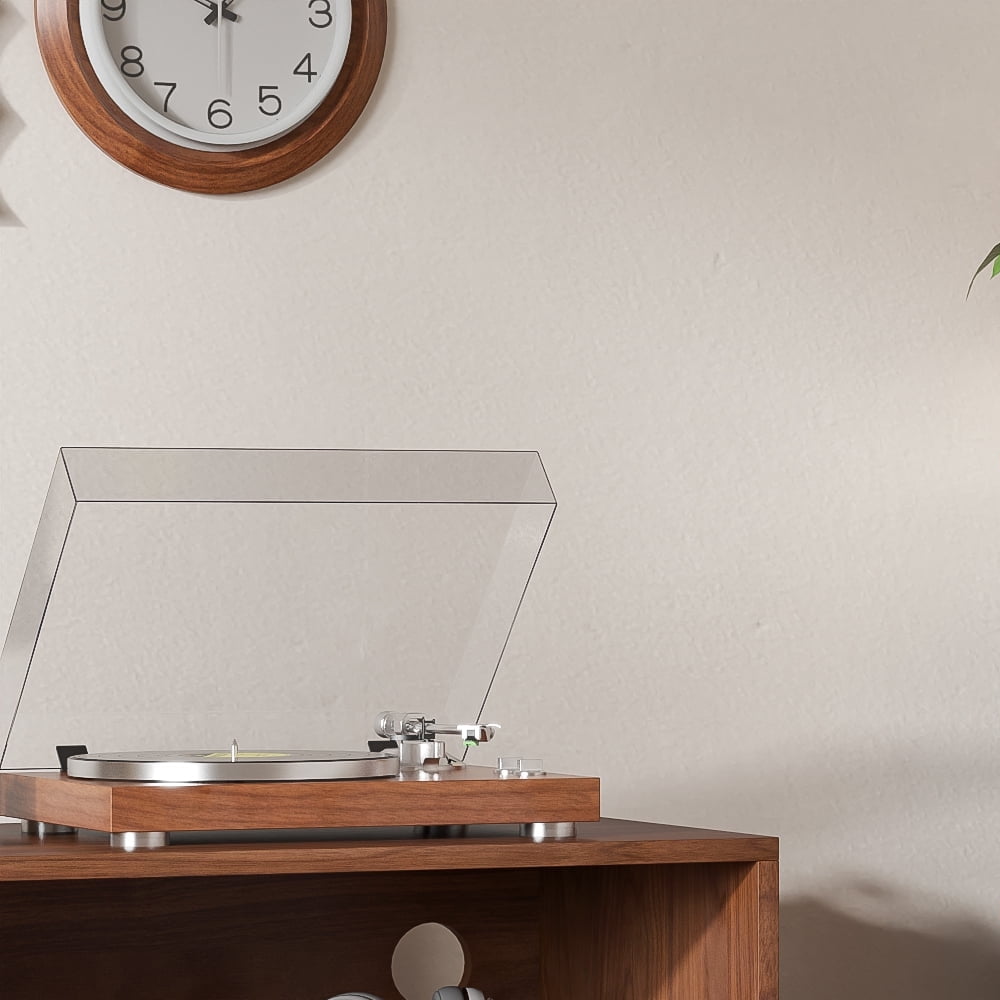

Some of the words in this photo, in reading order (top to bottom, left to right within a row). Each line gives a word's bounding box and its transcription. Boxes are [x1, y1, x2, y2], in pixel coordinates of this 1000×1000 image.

[308, 0, 332, 28] 3
[120, 46, 144, 77] 8
[293, 53, 317, 82] 4
[154, 82, 176, 112] 7
[258, 86, 281, 116] 5
[207, 99, 232, 128] 6
